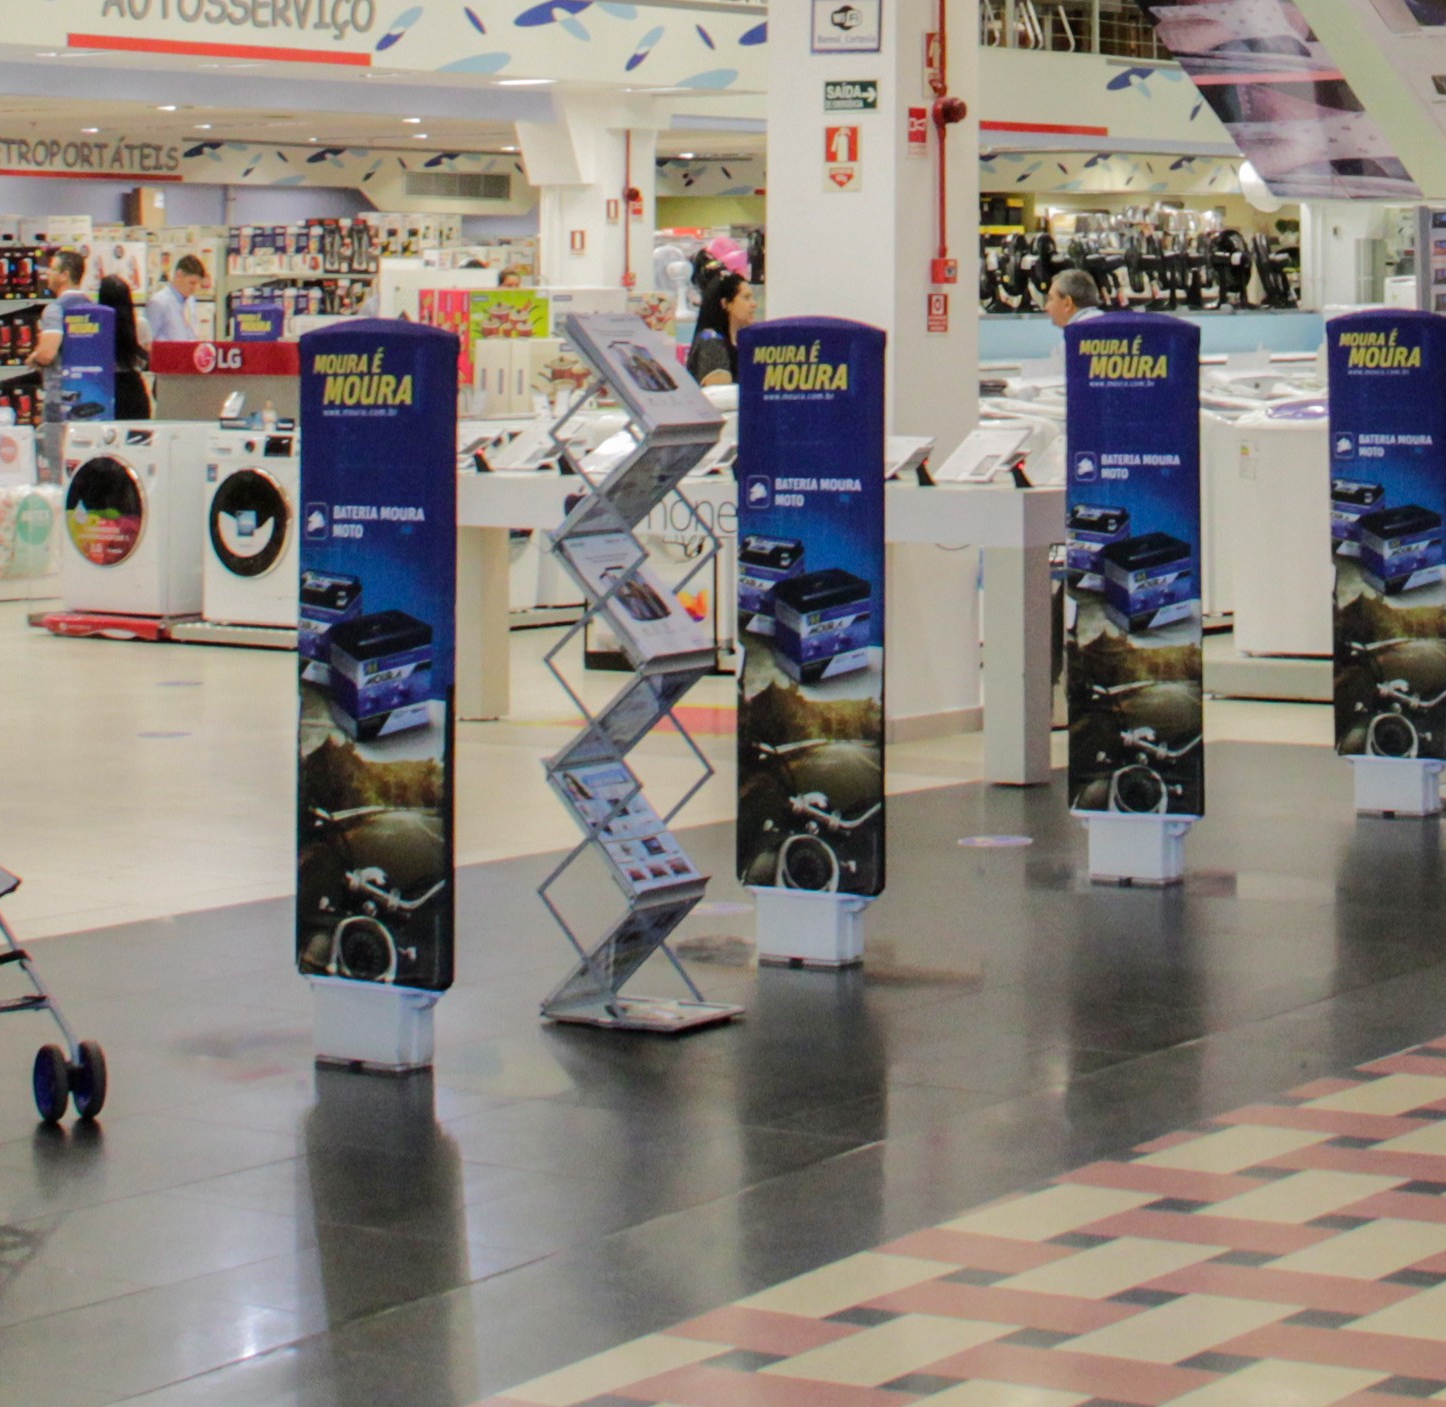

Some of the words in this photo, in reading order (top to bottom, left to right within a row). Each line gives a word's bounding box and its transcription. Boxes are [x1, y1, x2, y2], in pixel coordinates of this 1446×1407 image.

[826, 83, 862, 101] SAÍDA
[1079, 339, 1129, 355] MOURA
[1131, 334, 1143, 355] É
[1339, 332, 1385, 347] MOURA
[1388, 327, 1399, 347] É
[216, 348, 243, 369] LG
[313, 353, 368, 374] MOURA
[371, 347, 385, 374] É
[753, 345, 806, 364] MOURA
[809, 339, 821, 363] É
[1348, 346, 1422, 369] MOURA
[763, 363, 849, 391] MOURA
[1088, 355, 1168, 380] MOURA
[322, 374, 413, 406] MOURA
[1358, 433, 1397, 445] BATERIA
[1397, 434, 1434, 445] MOURA
[1100, 453, 1142, 466] BATERIA
[1142, 454, 1181, 466] MOURA
[774, 477, 819, 492] BATERIA
[819, 477, 863, 492] MOURA
[332, 505, 379, 521] BATERIA
[380, 506, 426, 522] MOURA
